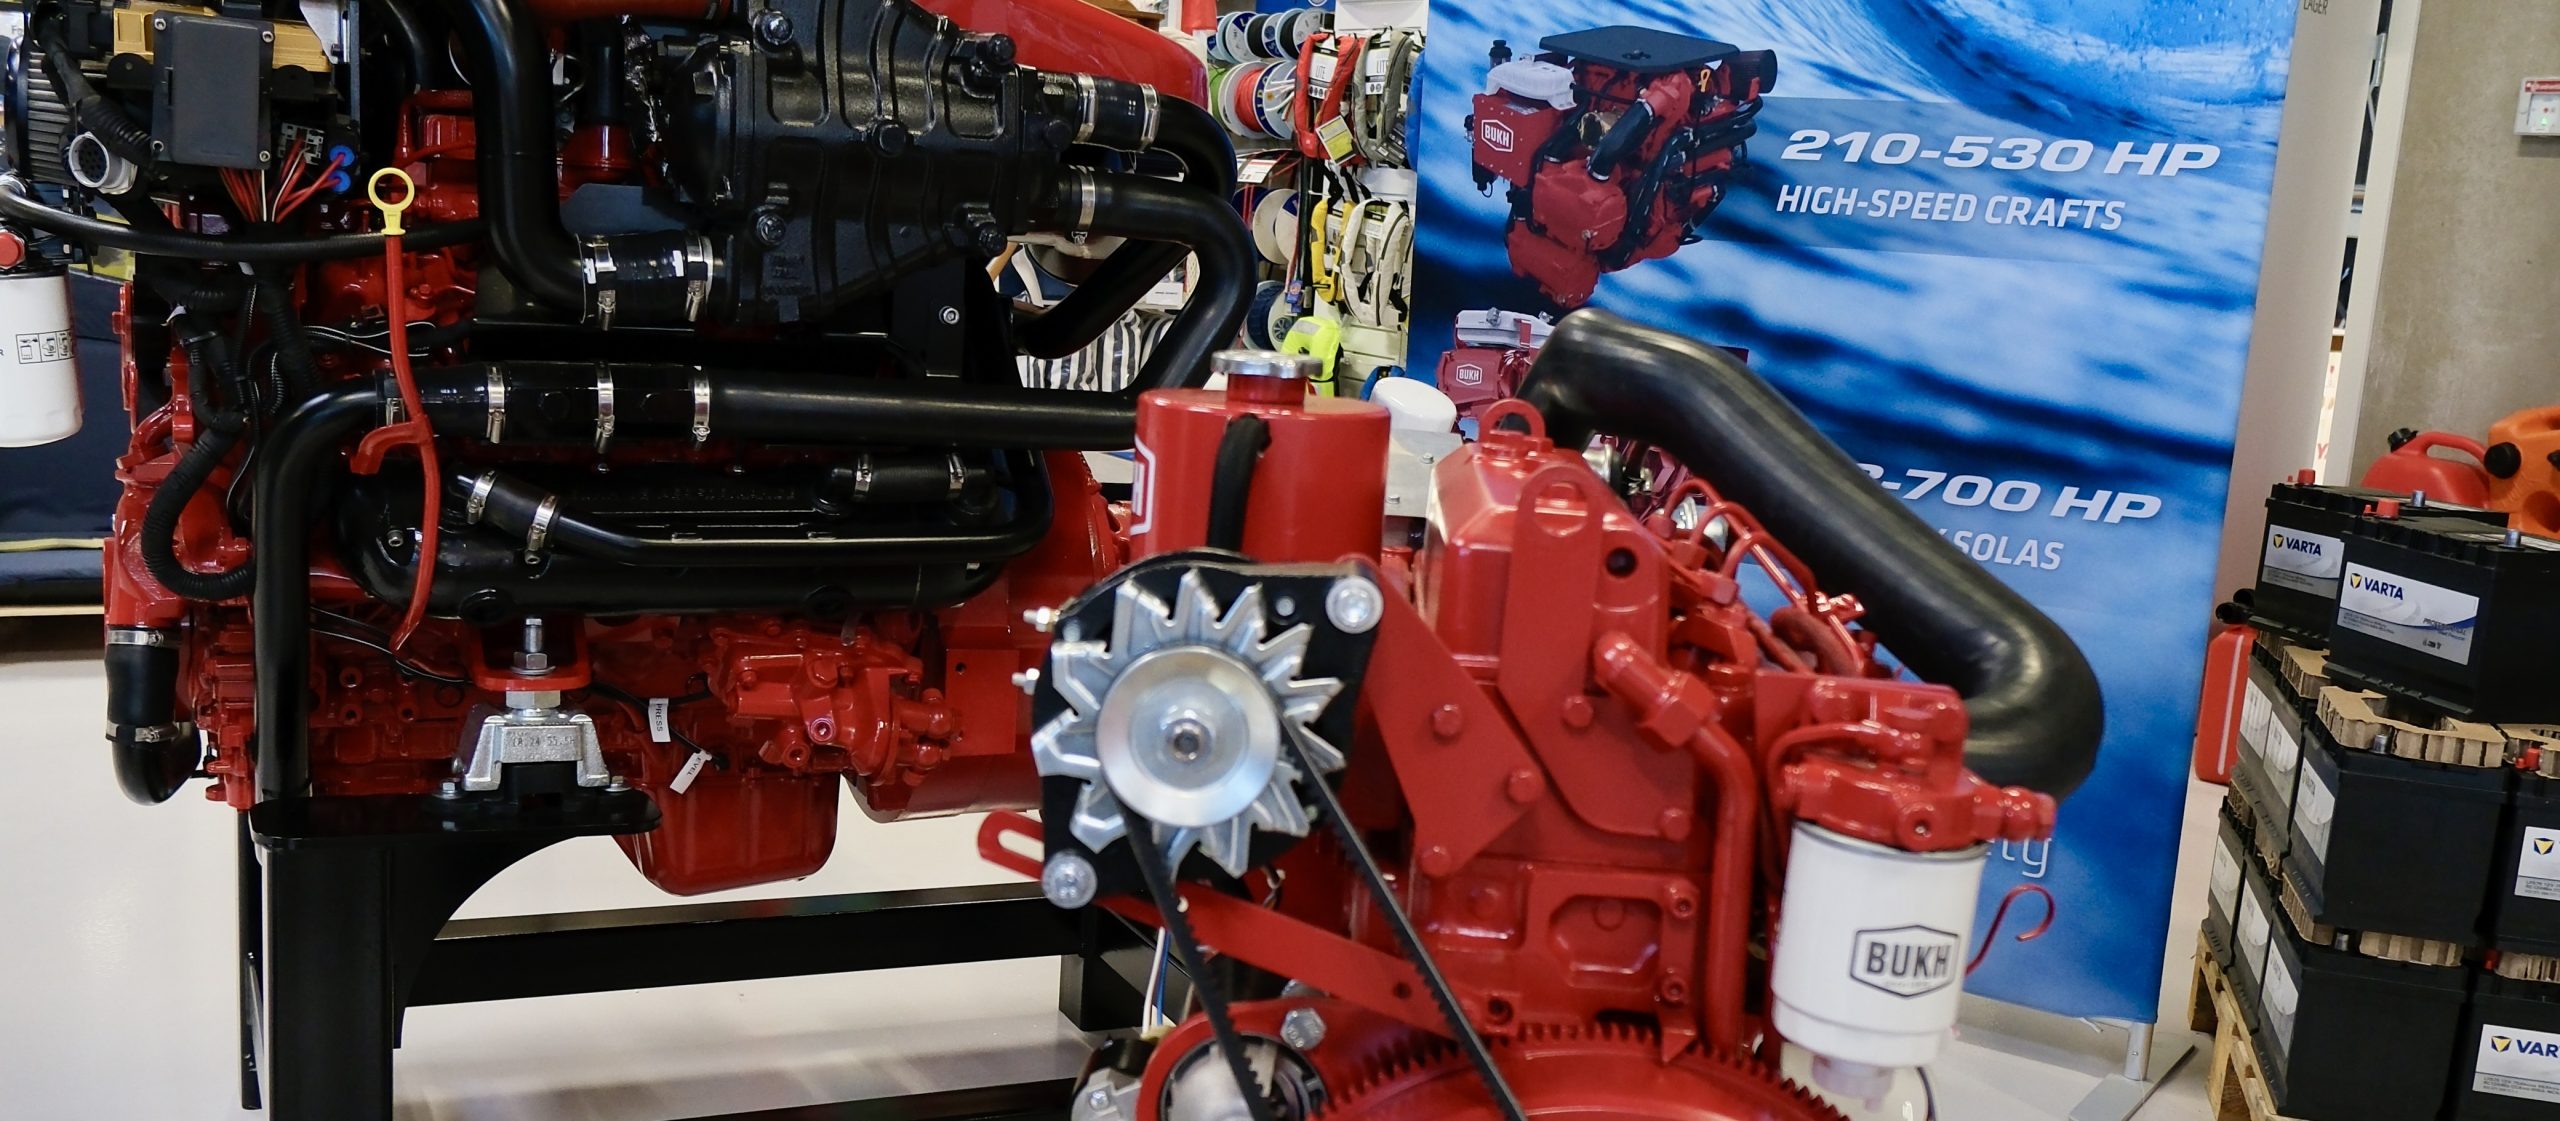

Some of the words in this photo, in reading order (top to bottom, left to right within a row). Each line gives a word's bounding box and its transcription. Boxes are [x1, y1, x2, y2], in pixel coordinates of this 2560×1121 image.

[1484, 124, 1510, 147] BUKH
[1780, 129, 2094, 172] 210-530
[2103, 141, 2221, 177] HP
[1775, 184, 1977, 223] HIGH-SPEED
[1985, 195, 2126, 231] CRAFTS
[1459, 368, 1479, 381] BUKH
[2050, 486, 2162, 524] HP
[1953, 529, 2065, 570] SOLAS
[2286, 537, 2321, 557] VARTA
[2364, 576, 2404, 601] VARTA
[655, 703, 664, 732] PRESS
[1866, 941, 1952, 977] BUKH
[2516, 1039, 2560, 1058] VAR
